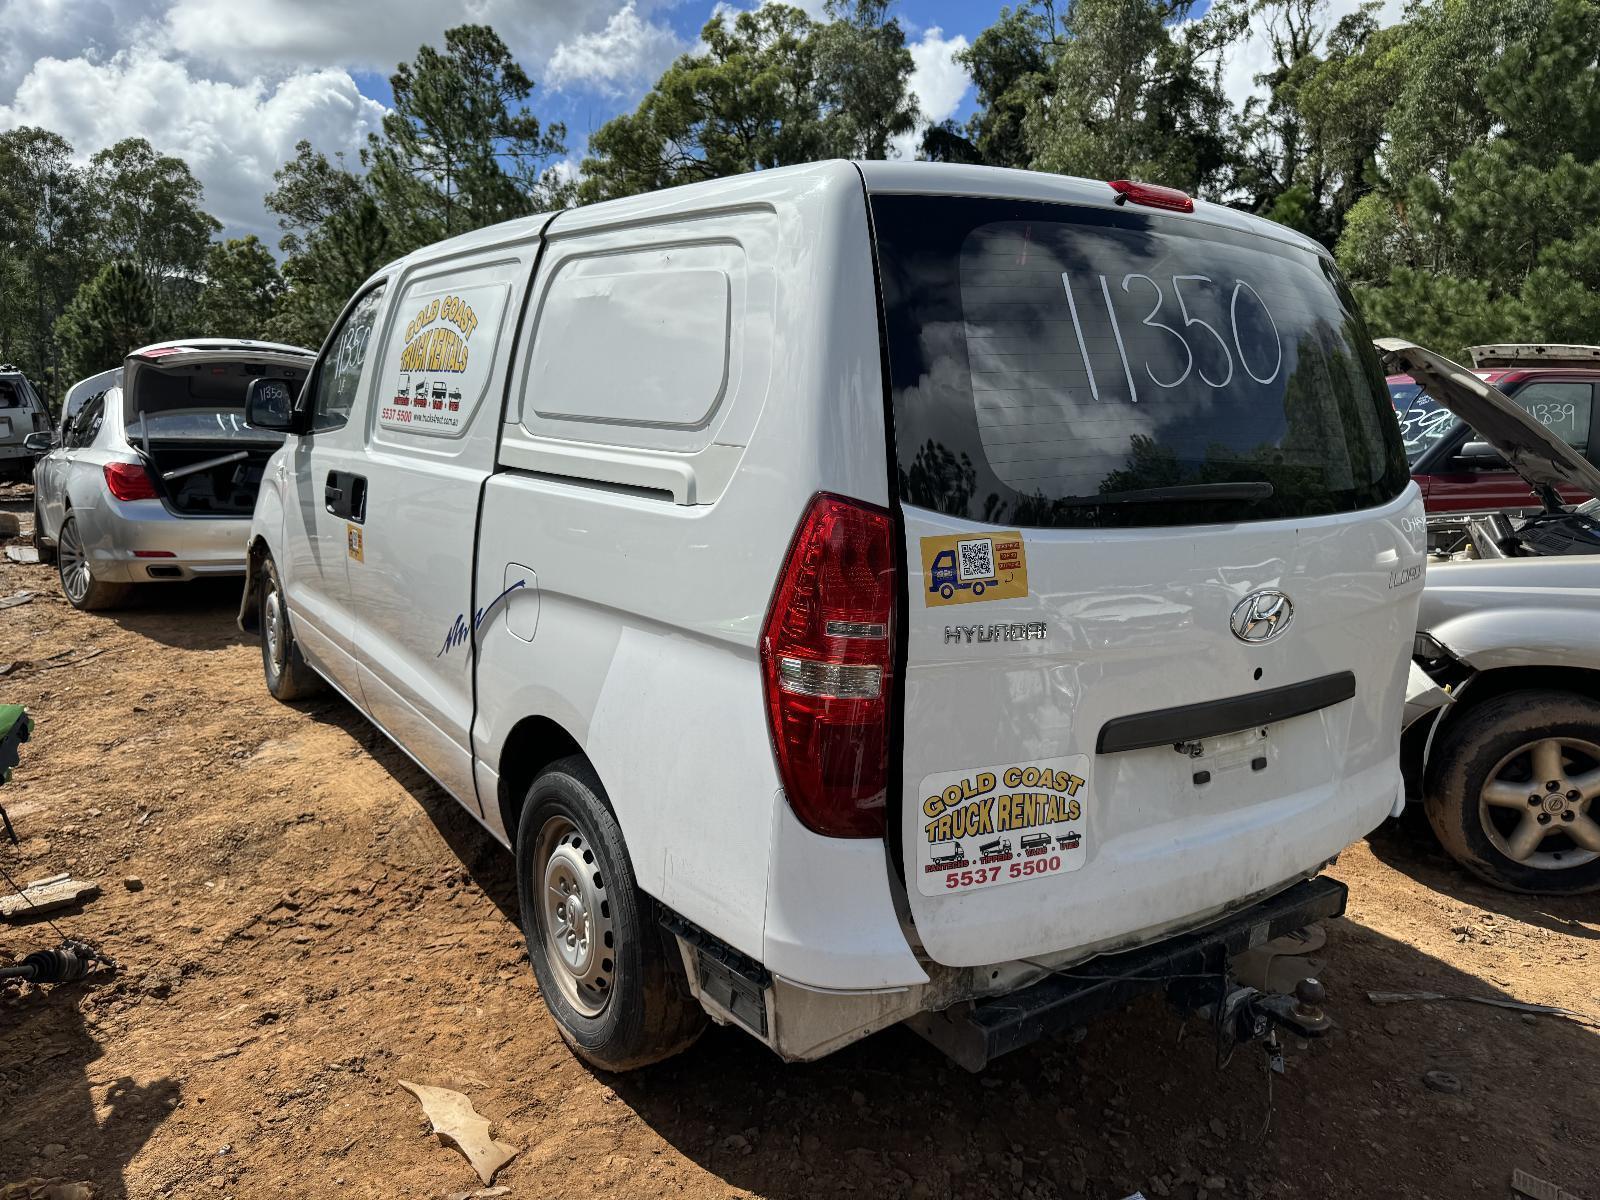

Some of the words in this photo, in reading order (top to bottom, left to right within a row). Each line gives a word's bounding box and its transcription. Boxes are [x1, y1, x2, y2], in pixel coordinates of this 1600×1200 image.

[404, 298, 441, 344] GOLD
[440, 295, 478, 343] COAST
[1061, 271, 1282, 402] 11350
[400, 329, 432, 373] TRUCK
[428, 328, 469, 374] RENTALS
[259, 386, 283, 401] 11350
[381, 407, 396, 420] 5537
[396, 408, 413, 423] 5500
[944, 622, 1048, 644] HYUNDAI
[922, 772, 996, 818] GOLD
[1003, 766, 1086, 797] COAST
[924, 796, 995, 842] TRUCK
[997, 793, 1081, 832] RENTALS
[924, 859, 969, 873] PANTECHS
[979, 852, 1013, 865] TIPPERS
[1025, 846, 1047, 857] VANS
[945, 865, 1002, 889] 5537
[1009, 855, 1061, 879] 5500
